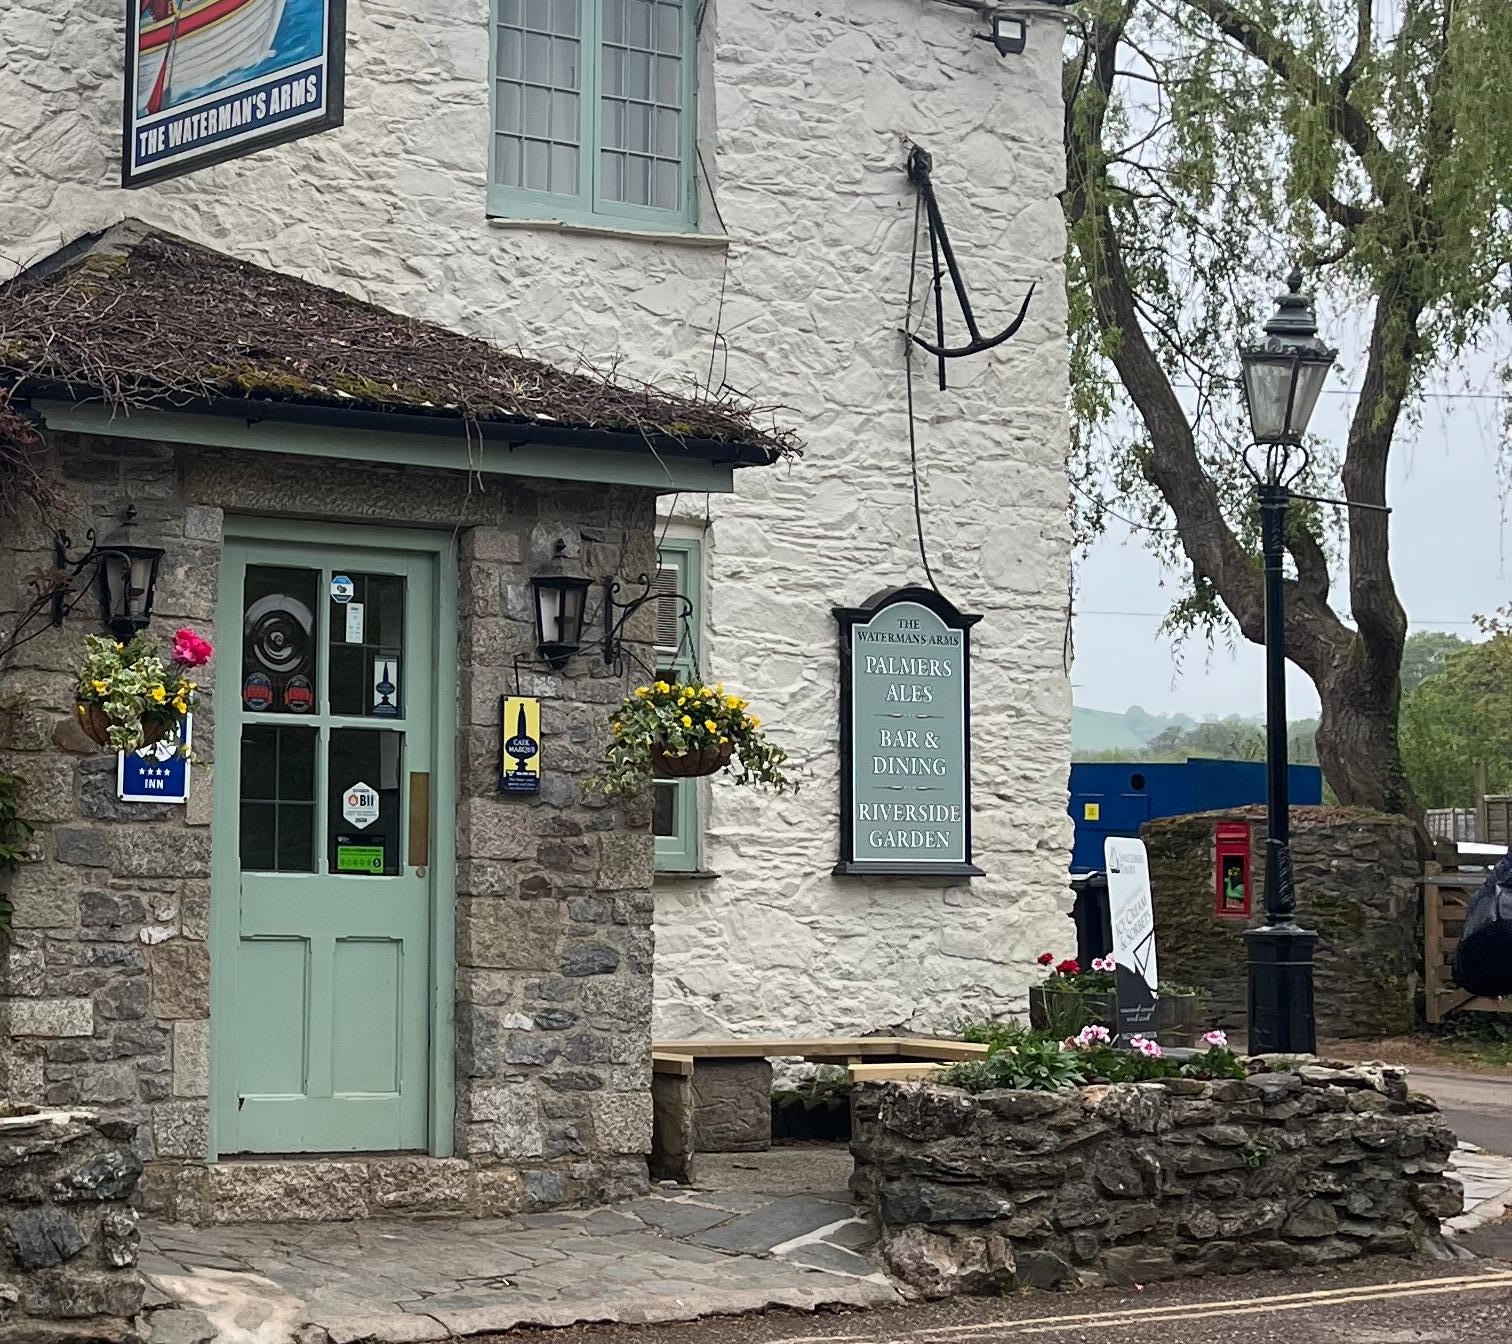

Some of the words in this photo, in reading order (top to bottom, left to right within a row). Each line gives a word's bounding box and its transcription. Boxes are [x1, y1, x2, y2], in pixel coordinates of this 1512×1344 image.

[139, 127, 165, 157] THE
[168, 91, 267, 148] WATERMAN'S
[269, 74, 317, 116] ARMS
[897, 619, 920, 630] THE
[858, 632, 926, 645] WATERMANS
[929, 636, 959, 646] ARMS
[865, 655, 952, 677] PALMERS
[886, 683, 933, 703] ALES
[880, 729, 919, 749] BAR
[924, 731, 940, 749] &
[872, 756, 946, 776] DINING
[144, 778, 164, 789] INN
[858, 803, 962, 824] RIVERSIDE
[869, 830, 950, 849] GARDEN
